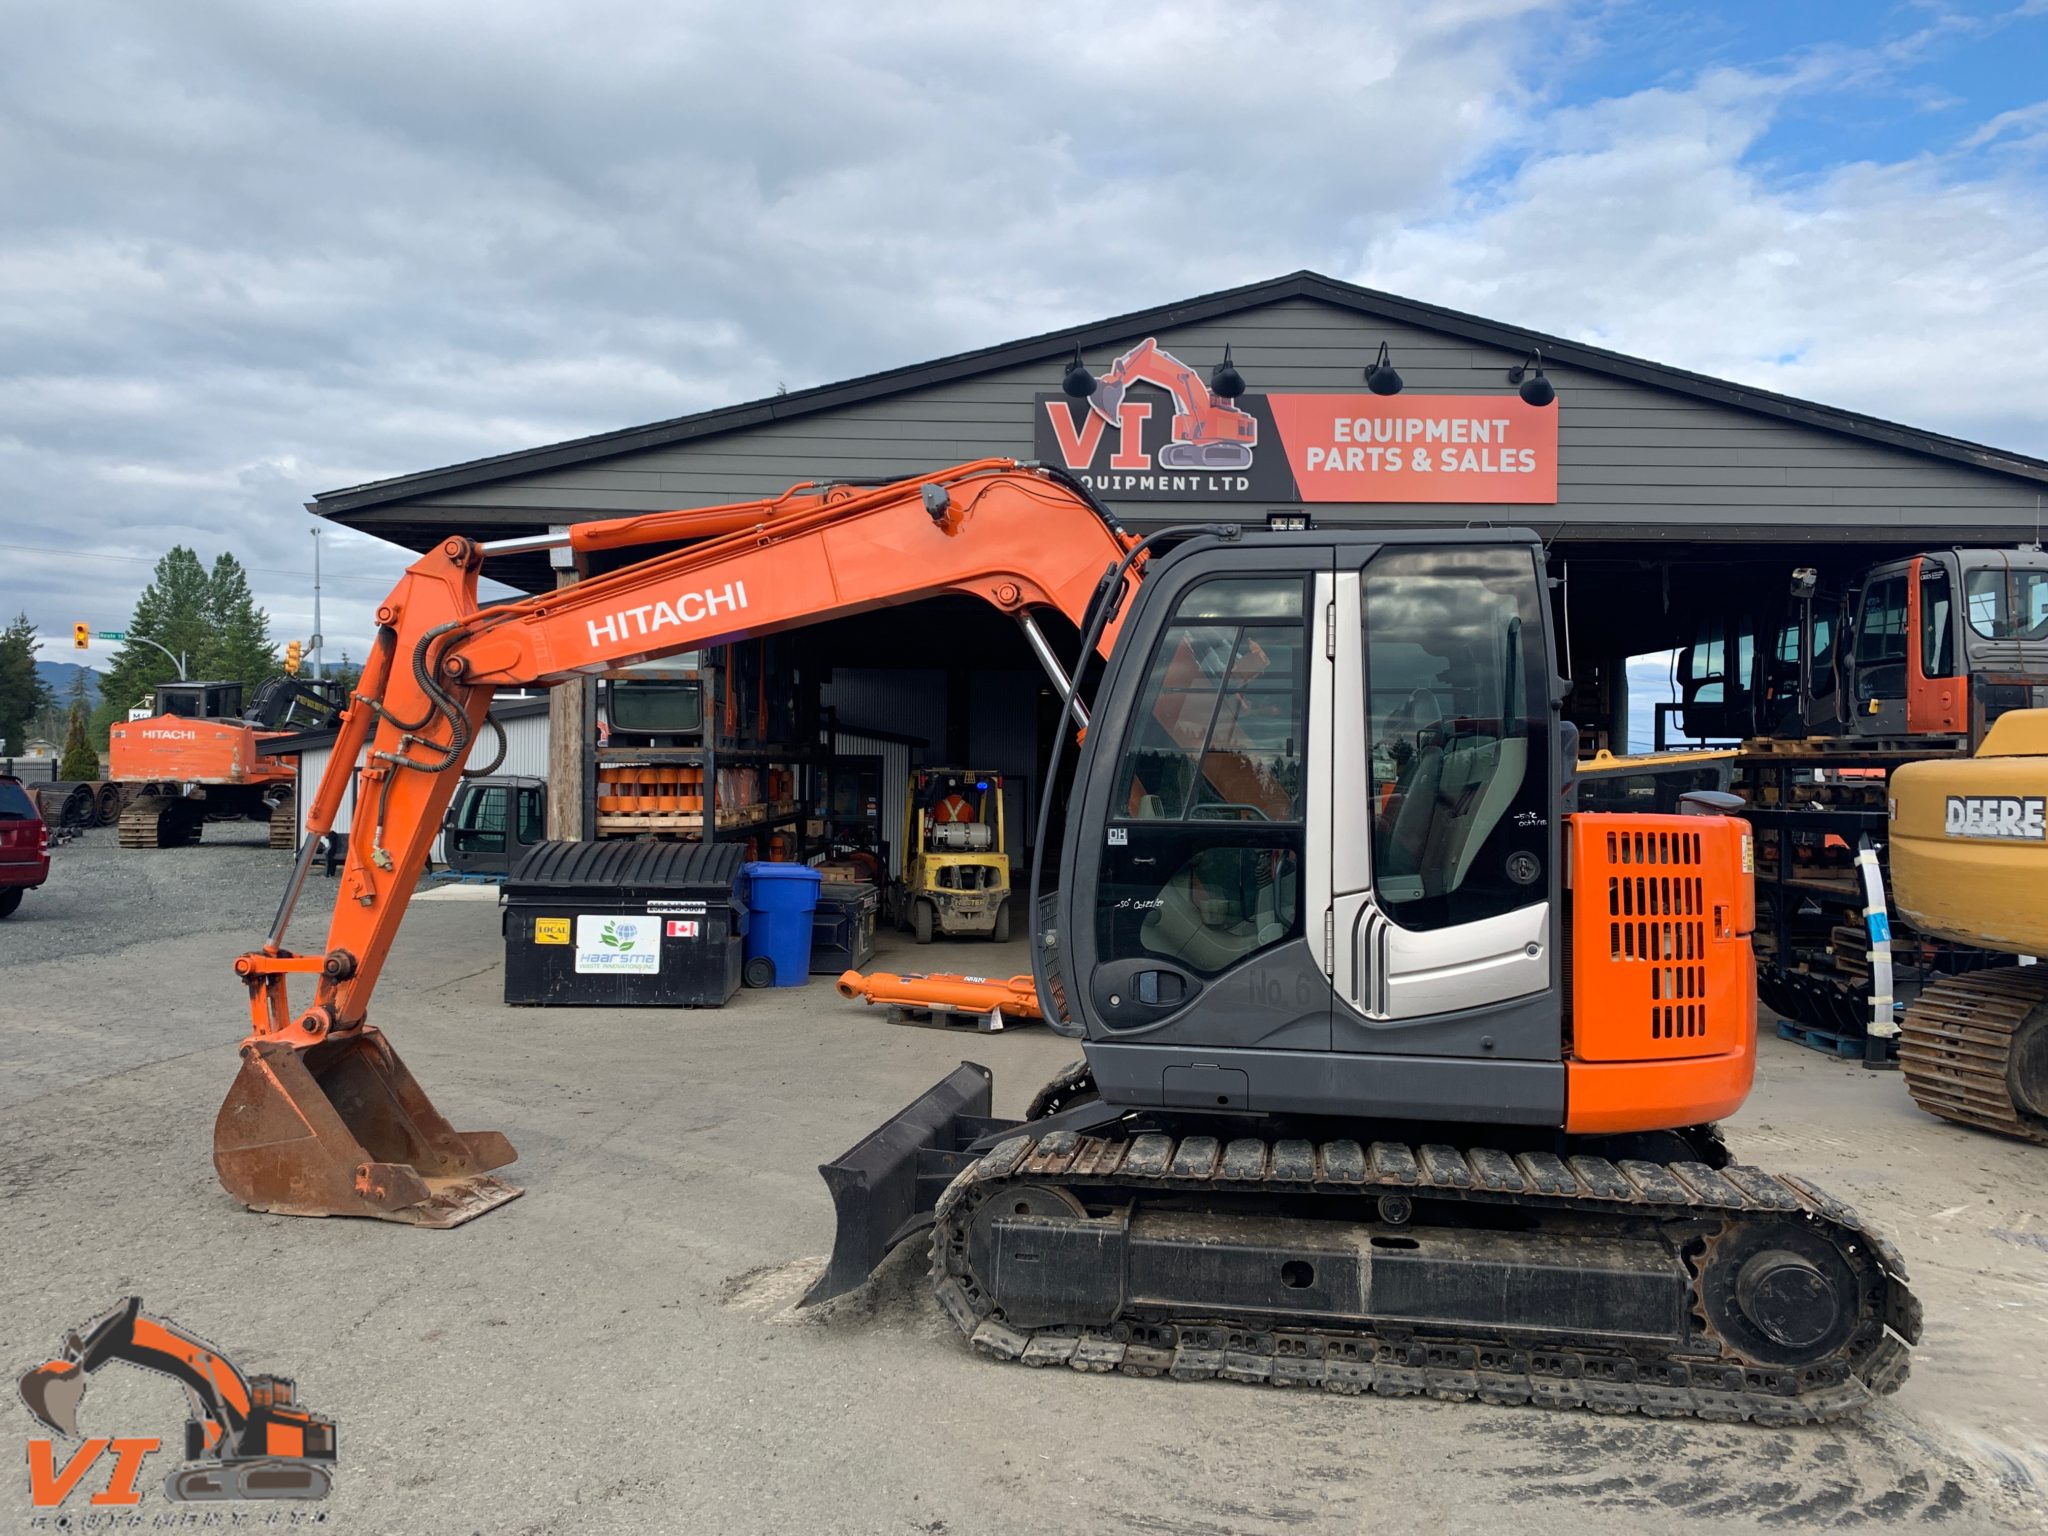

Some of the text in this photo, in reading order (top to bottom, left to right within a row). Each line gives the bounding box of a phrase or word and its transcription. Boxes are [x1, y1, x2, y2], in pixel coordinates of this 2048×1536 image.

[1045, 401, 1152, 470] VI
[1334, 418, 1510, 443] EQUIPMENT
[1306, 447, 1536, 473] PARTS & SALES
[1080, 475, 1249, 491] QUIPMENT LTD
[586, 580, 748, 647] HITACHI
[142, 729, 196, 740] HITACHI
[1945, 796, 2046, 840] DEERE
